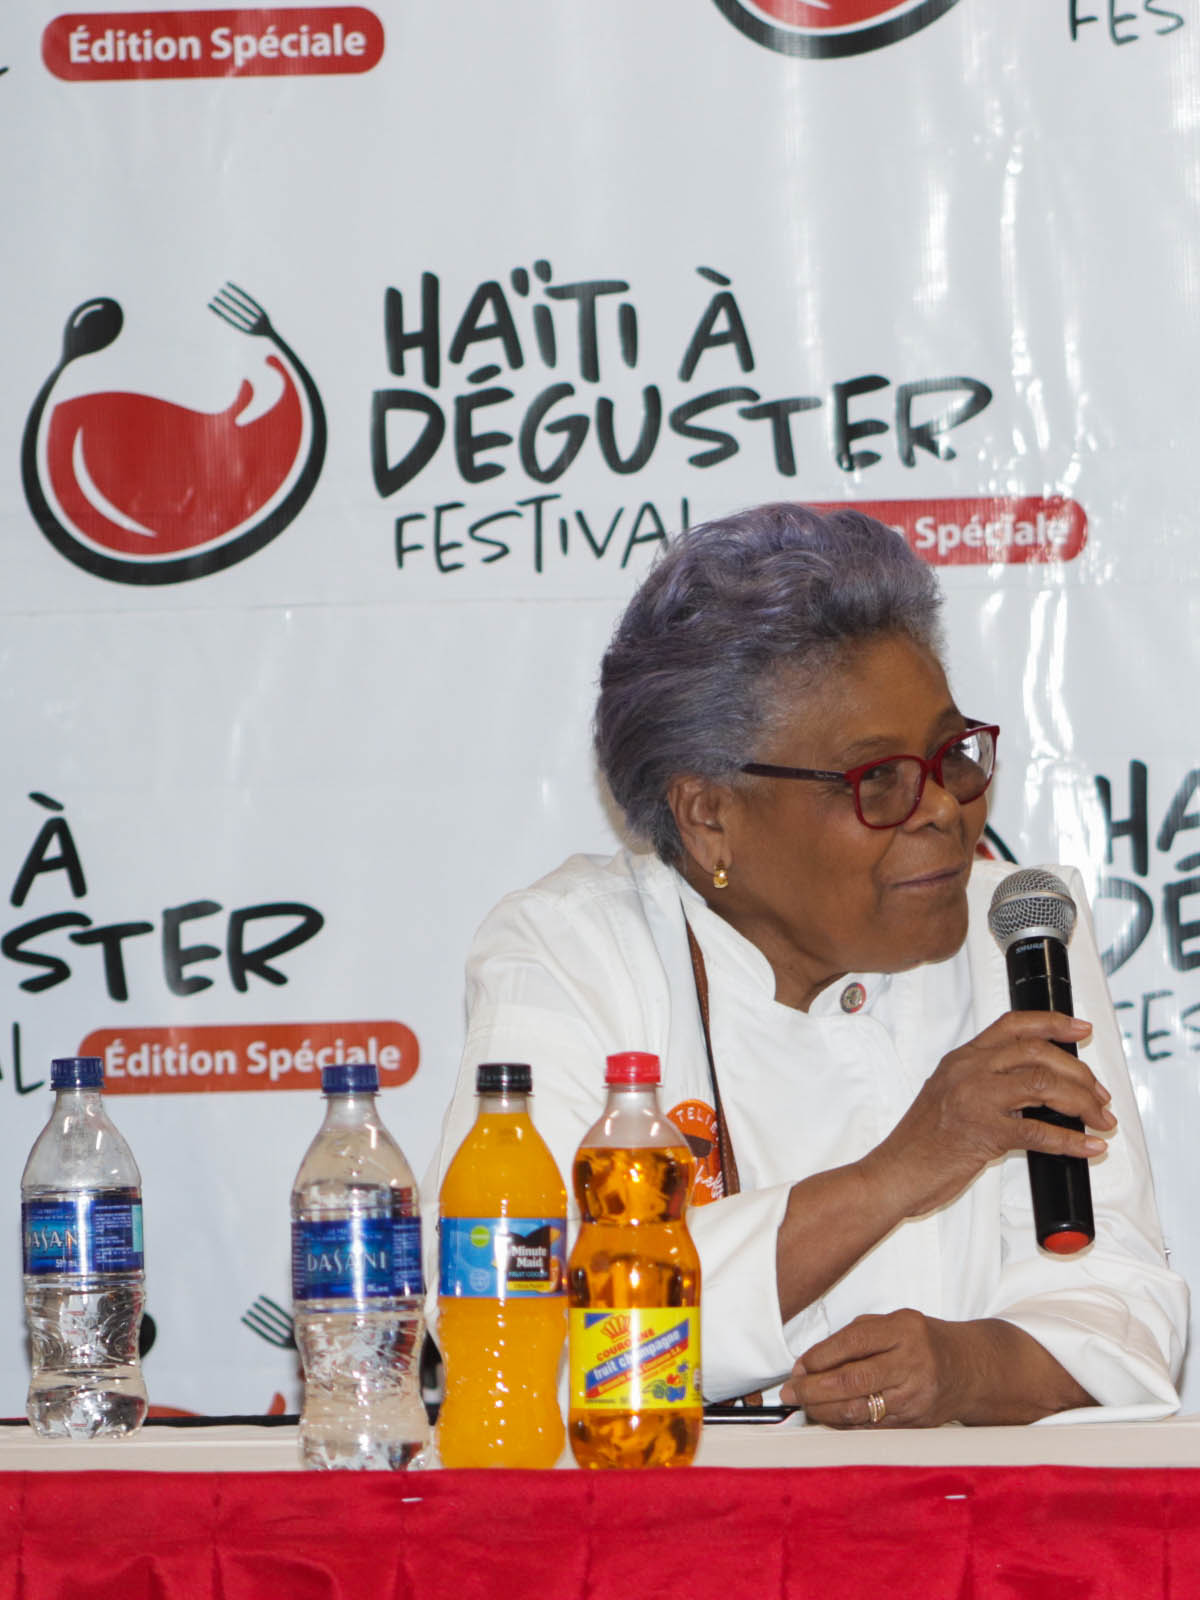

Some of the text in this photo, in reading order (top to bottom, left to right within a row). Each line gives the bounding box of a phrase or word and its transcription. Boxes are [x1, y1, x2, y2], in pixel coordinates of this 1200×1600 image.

[68, 23, 366, 67] Édition Spéciale
[384, 259, 756, 389] HAÏTI À
[370, 364, 993, 500] DÉGUSTER
[914, 511, 1070, 557] Spéciale
[10, 791, 87, 907] À
[104, 1036, 401, 1080] Édition Spéciale
[510, 1246, 548, 1257] Minute
[516, 1257, 545, 1268] Maid
